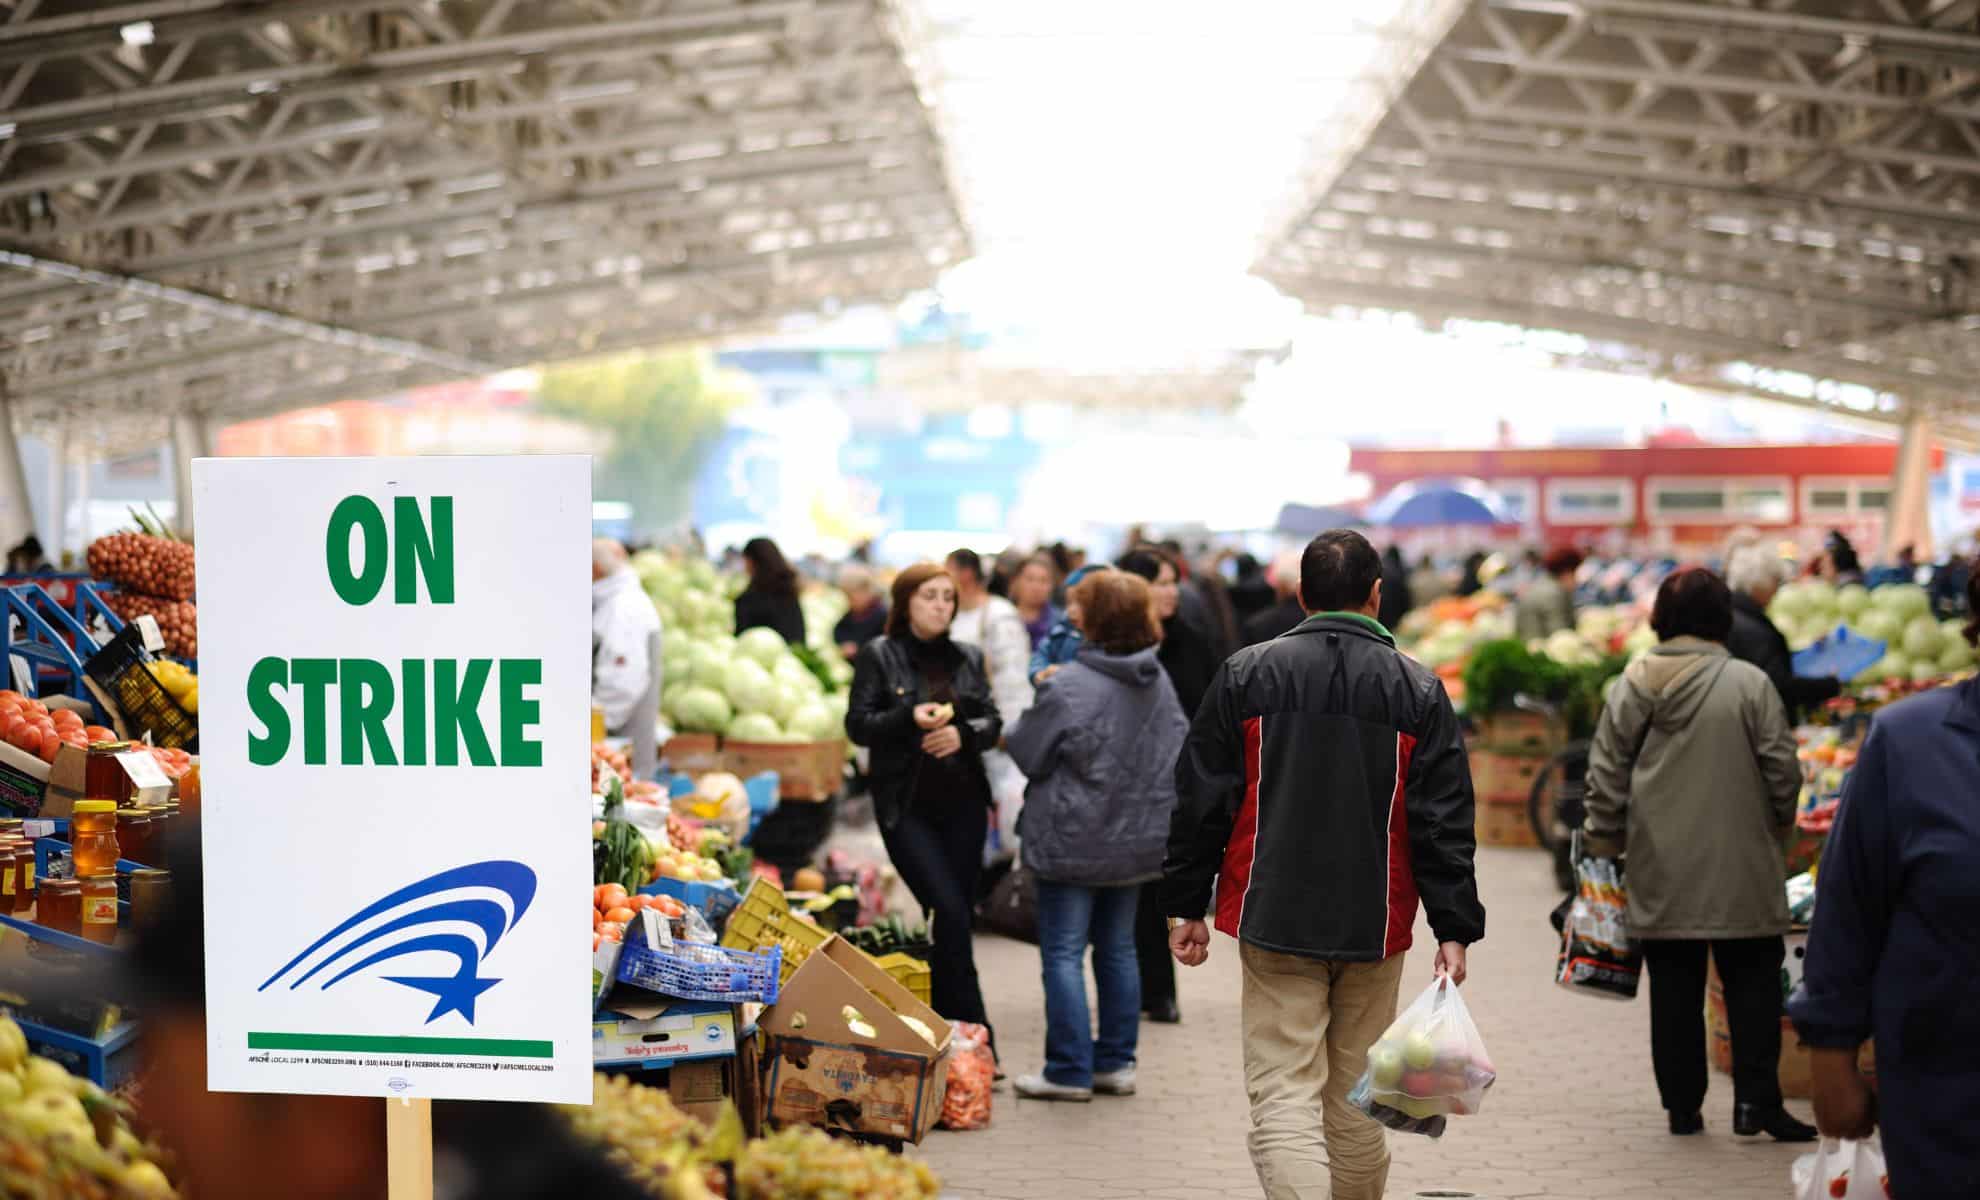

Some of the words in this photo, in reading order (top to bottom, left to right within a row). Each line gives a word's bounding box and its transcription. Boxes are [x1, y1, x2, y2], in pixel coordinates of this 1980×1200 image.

[326, 496, 455, 606] ON
[247, 656, 543, 767] STRIKE
[248, 1054, 270, 1063] AFSCME
[271, 1056, 289, 1064] LOCAL
